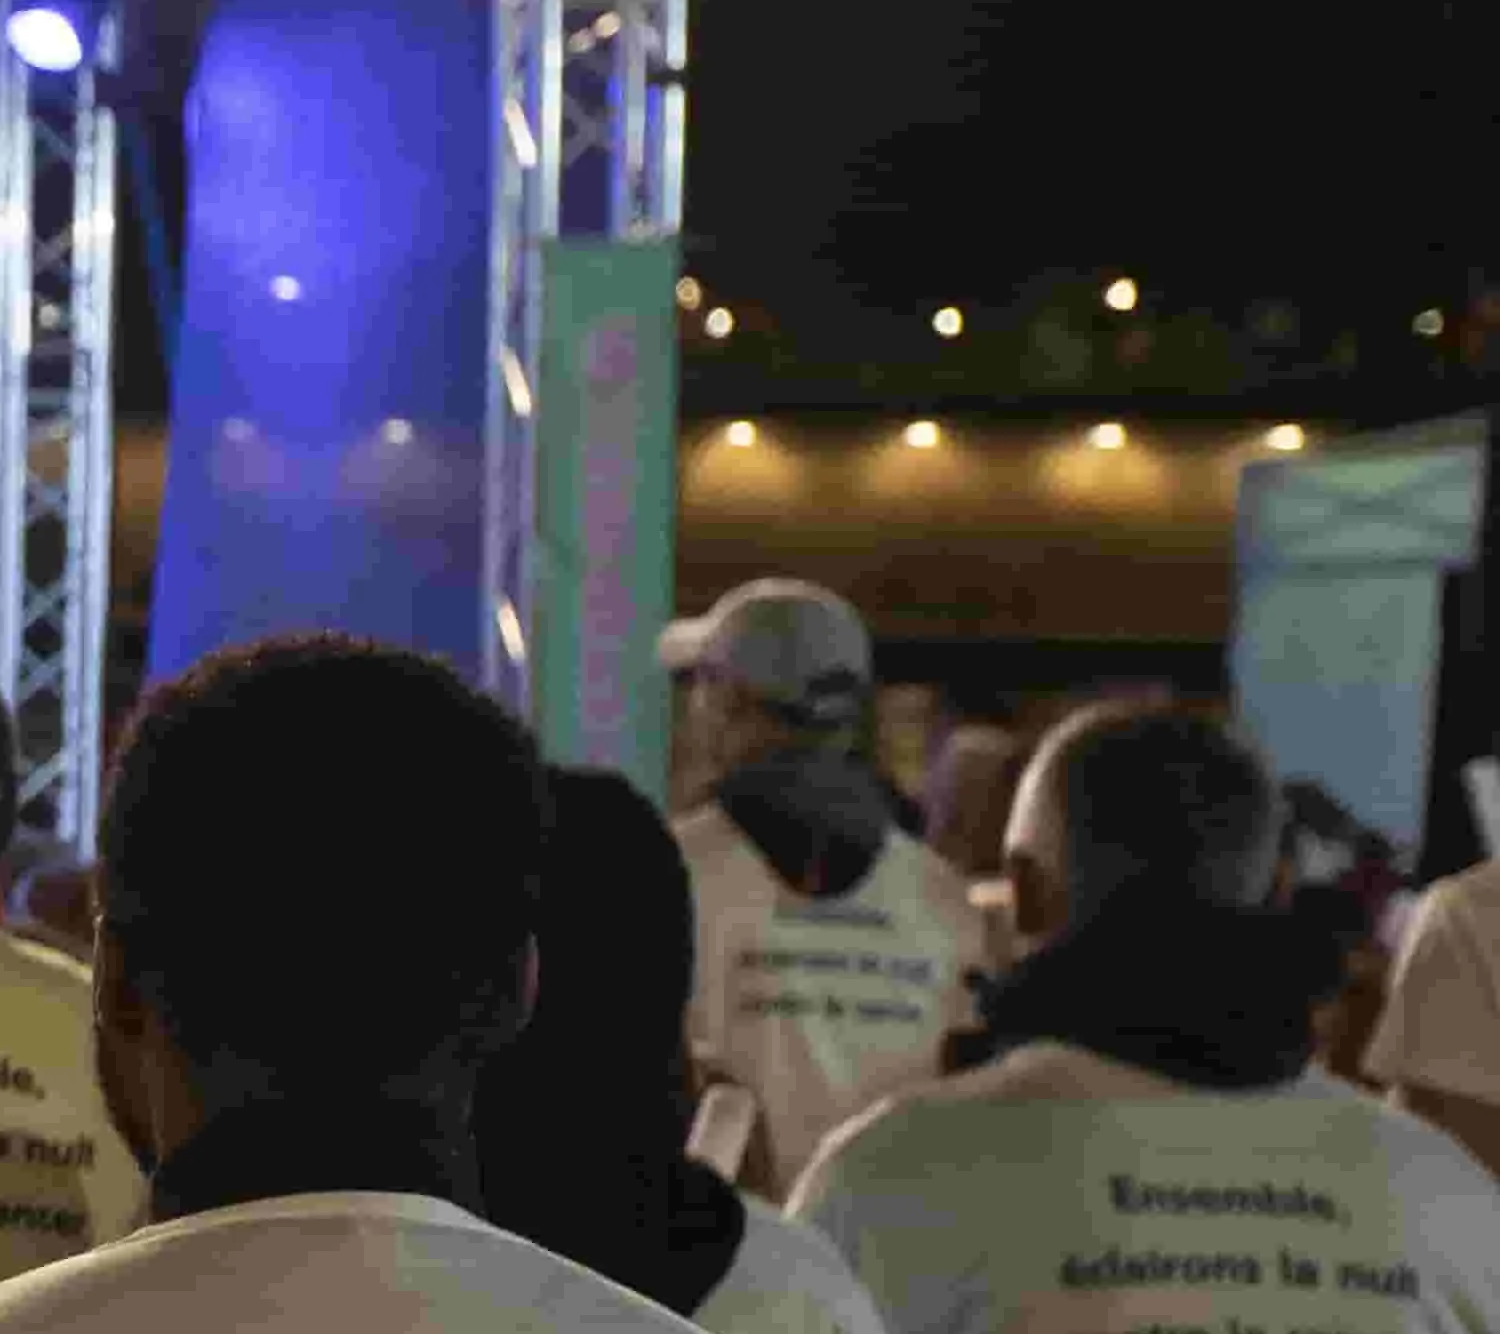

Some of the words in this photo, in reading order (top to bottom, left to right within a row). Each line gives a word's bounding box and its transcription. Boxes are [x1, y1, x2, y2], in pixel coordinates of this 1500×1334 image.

[1107, 1173, 1353, 1235] Ensemble,
[1060, 1243, 1264, 1290] éclairons
[1279, 1242, 1321, 1286] la
